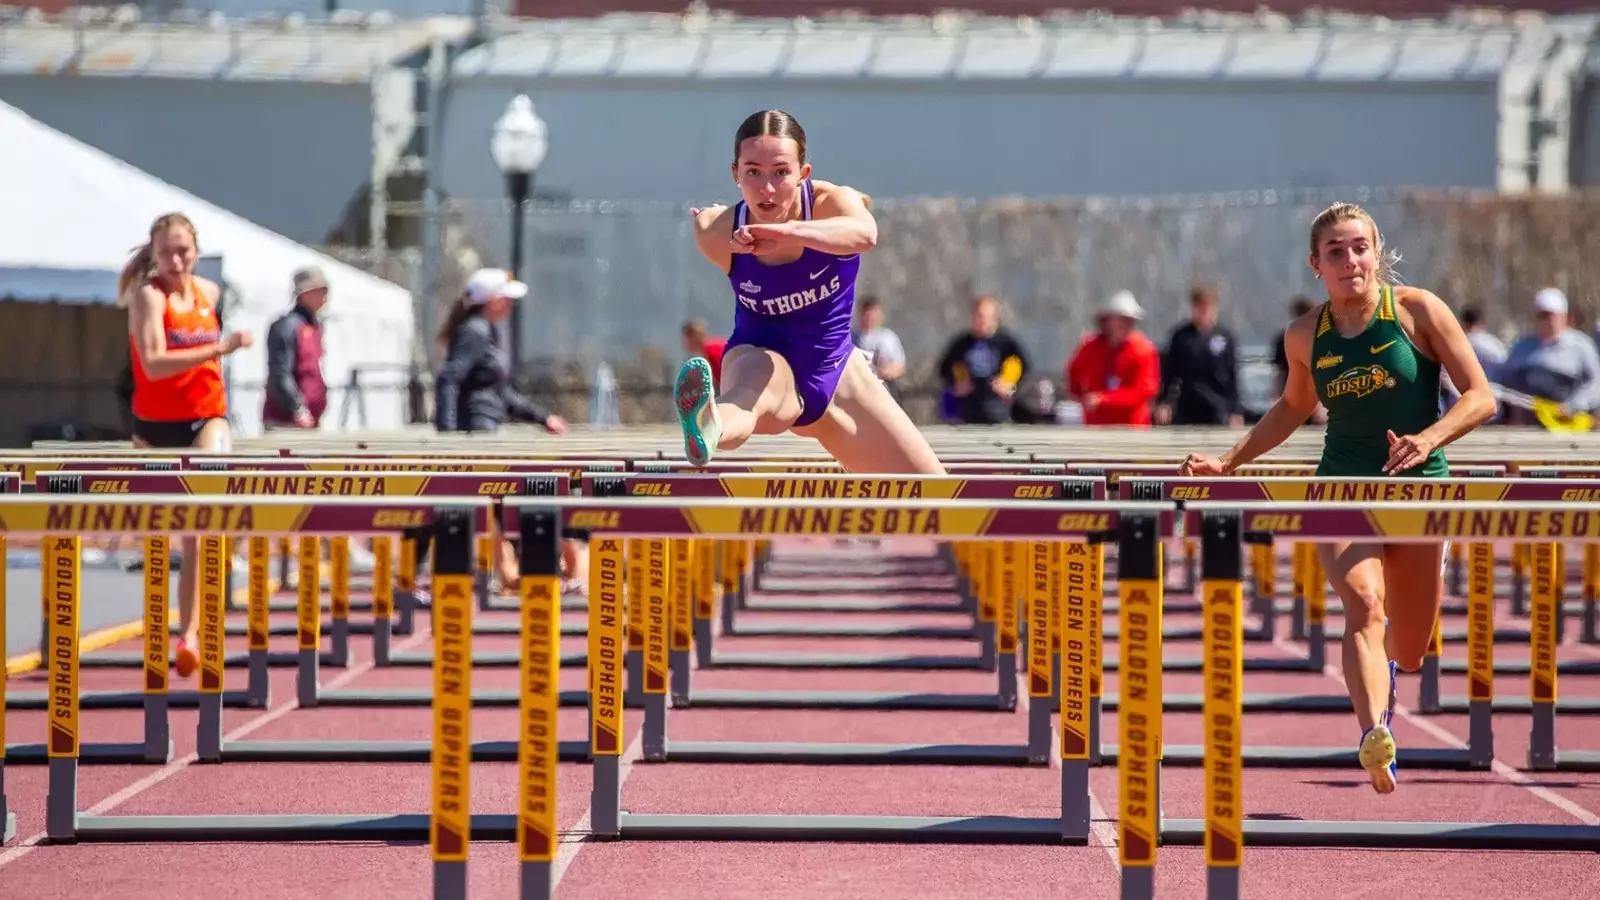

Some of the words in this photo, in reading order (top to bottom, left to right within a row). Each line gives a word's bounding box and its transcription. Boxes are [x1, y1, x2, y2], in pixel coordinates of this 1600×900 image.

[762, 275, 840, 316] THOMAS
[1327, 375, 1371, 398] NDSU
[89, 480, 131, 494] GILL
[226, 477, 386, 495] MINNESOTA
[477, 482, 518, 495] GILL
[632, 483, 672, 496] GILL
[764, 480, 923, 498] MINNESOTA
[1014, 485, 1054, 499] GILL
[1170, 486, 1211, 499] GILL
[1305, 483, 1467, 501] MINNESOTA
[47, 504, 256, 531] MINNESOTA
[372, 509, 425, 528] GILL
[568, 510, 621, 529] GILL
[738, 508, 941, 534] MINNESOTA
[1057, 513, 1110, 531] GILL
[1250, 513, 1303, 531] GILL
[1424, 510, 1600, 536] MINNESO
[150, 537, 164, 587] OLDEN
[206, 537, 219, 587] OLDEN
[650, 539, 662, 588] OLDEN
[1034, 541, 1048, 592] OLDEN
[56, 556, 72, 627] GOLDEN
[600, 558, 616, 627] GOLDEN
[1068, 562, 1084, 631] GOLDEN
[150, 594, 163, 663] GOPHERS
[205, 593, 219, 662] GOPHERS
[441, 606, 464, 695] GOLDEN
[527, 607, 550, 697] GOLDEN
[649, 595, 662, 664] GOPHERS
[1034, 600, 1047, 667] GOPHERS
[1474, 603, 1488, 671] GOPHERS
[1536, 604, 1550, 671] GOPHERS
[55, 636, 72, 719] GOPHERS
[600, 636, 615, 719] GOPHERS
[1067, 640, 1083, 722] GOPHERS
[1127, 612, 1149, 702] GOLDEN
[1212, 613, 1233, 702] GOLDEN
[439, 707, 463, 813] GOPHERS
[526, 708, 549, 813] GOPHERS
[1126, 713, 1148, 818] GOPHERS
[1213, 714, 1234, 819] GOPHERS
